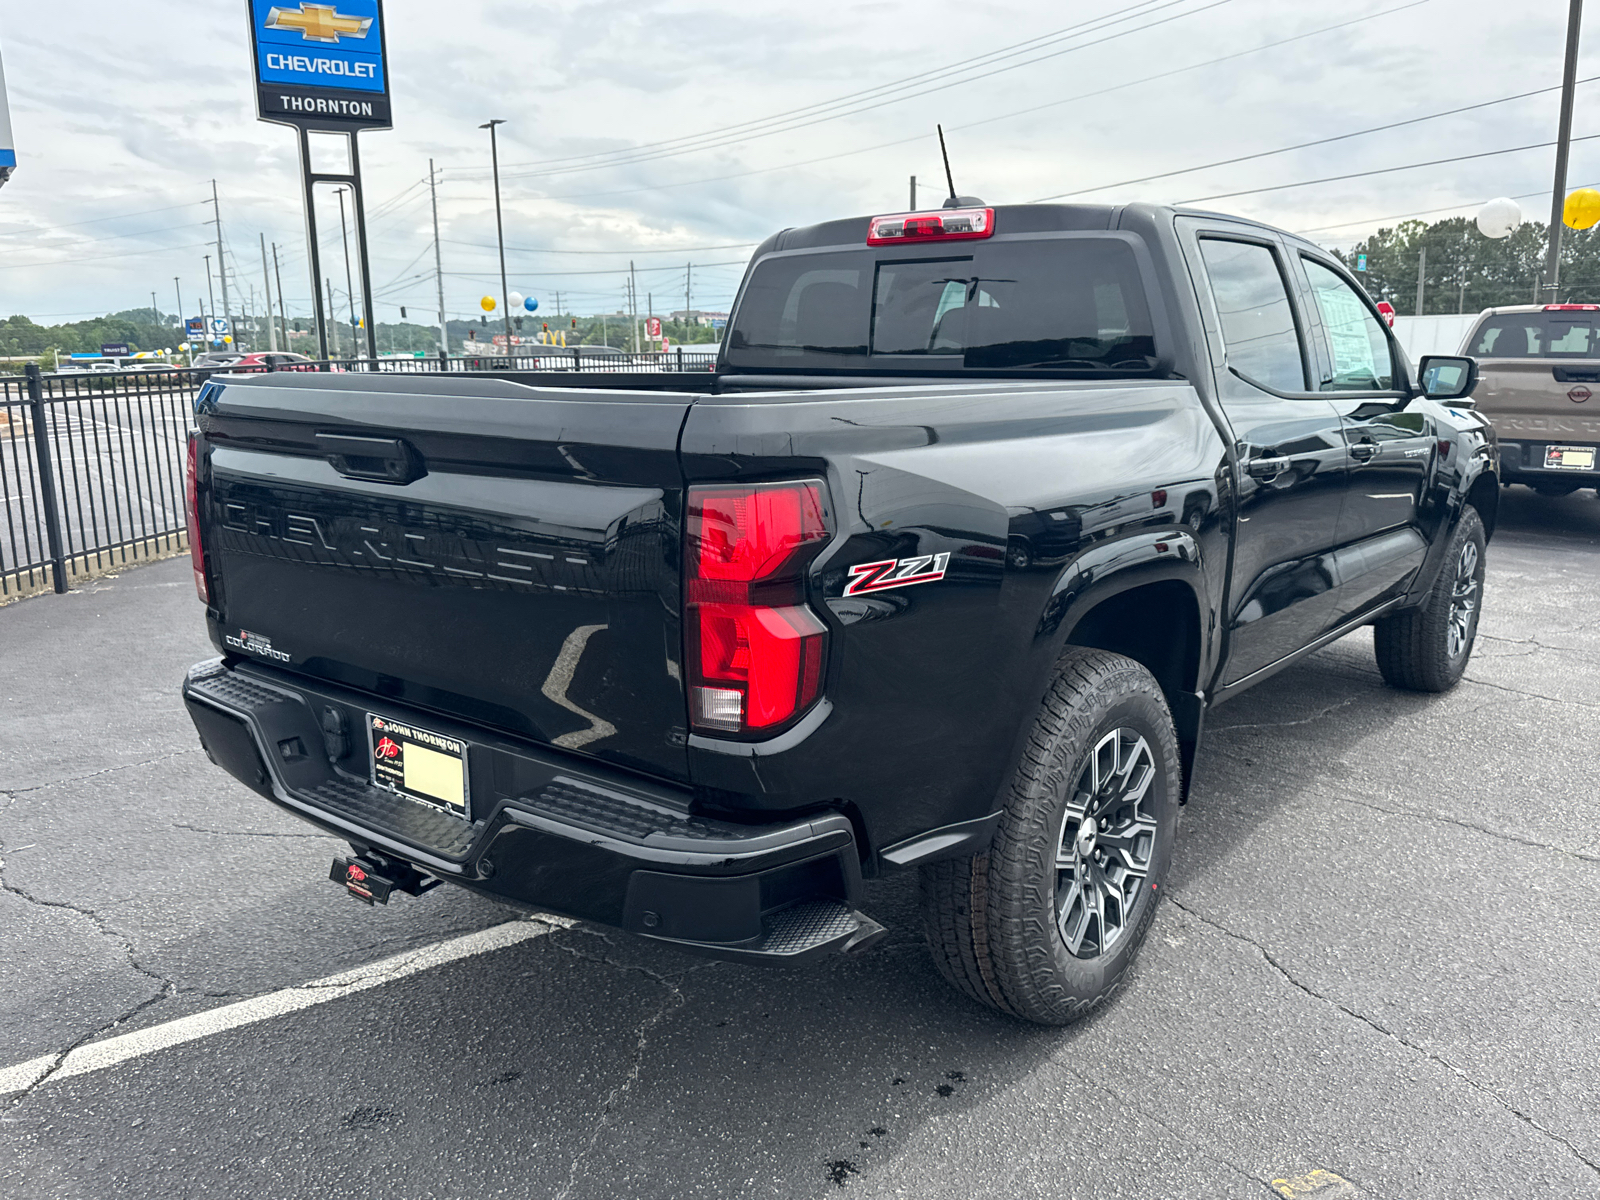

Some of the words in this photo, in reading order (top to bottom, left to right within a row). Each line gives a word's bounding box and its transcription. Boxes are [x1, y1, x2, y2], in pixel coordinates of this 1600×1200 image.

[266, 53, 377, 79] CHEVROLET
[280, 95, 373, 117] THORNTON
[843, 552, 951, 597] Z71
[225, 635, 291, 662] COLORADO
[389, 722, 412, 737] JOHN
[411, 730, 461, 753] THORNTON
